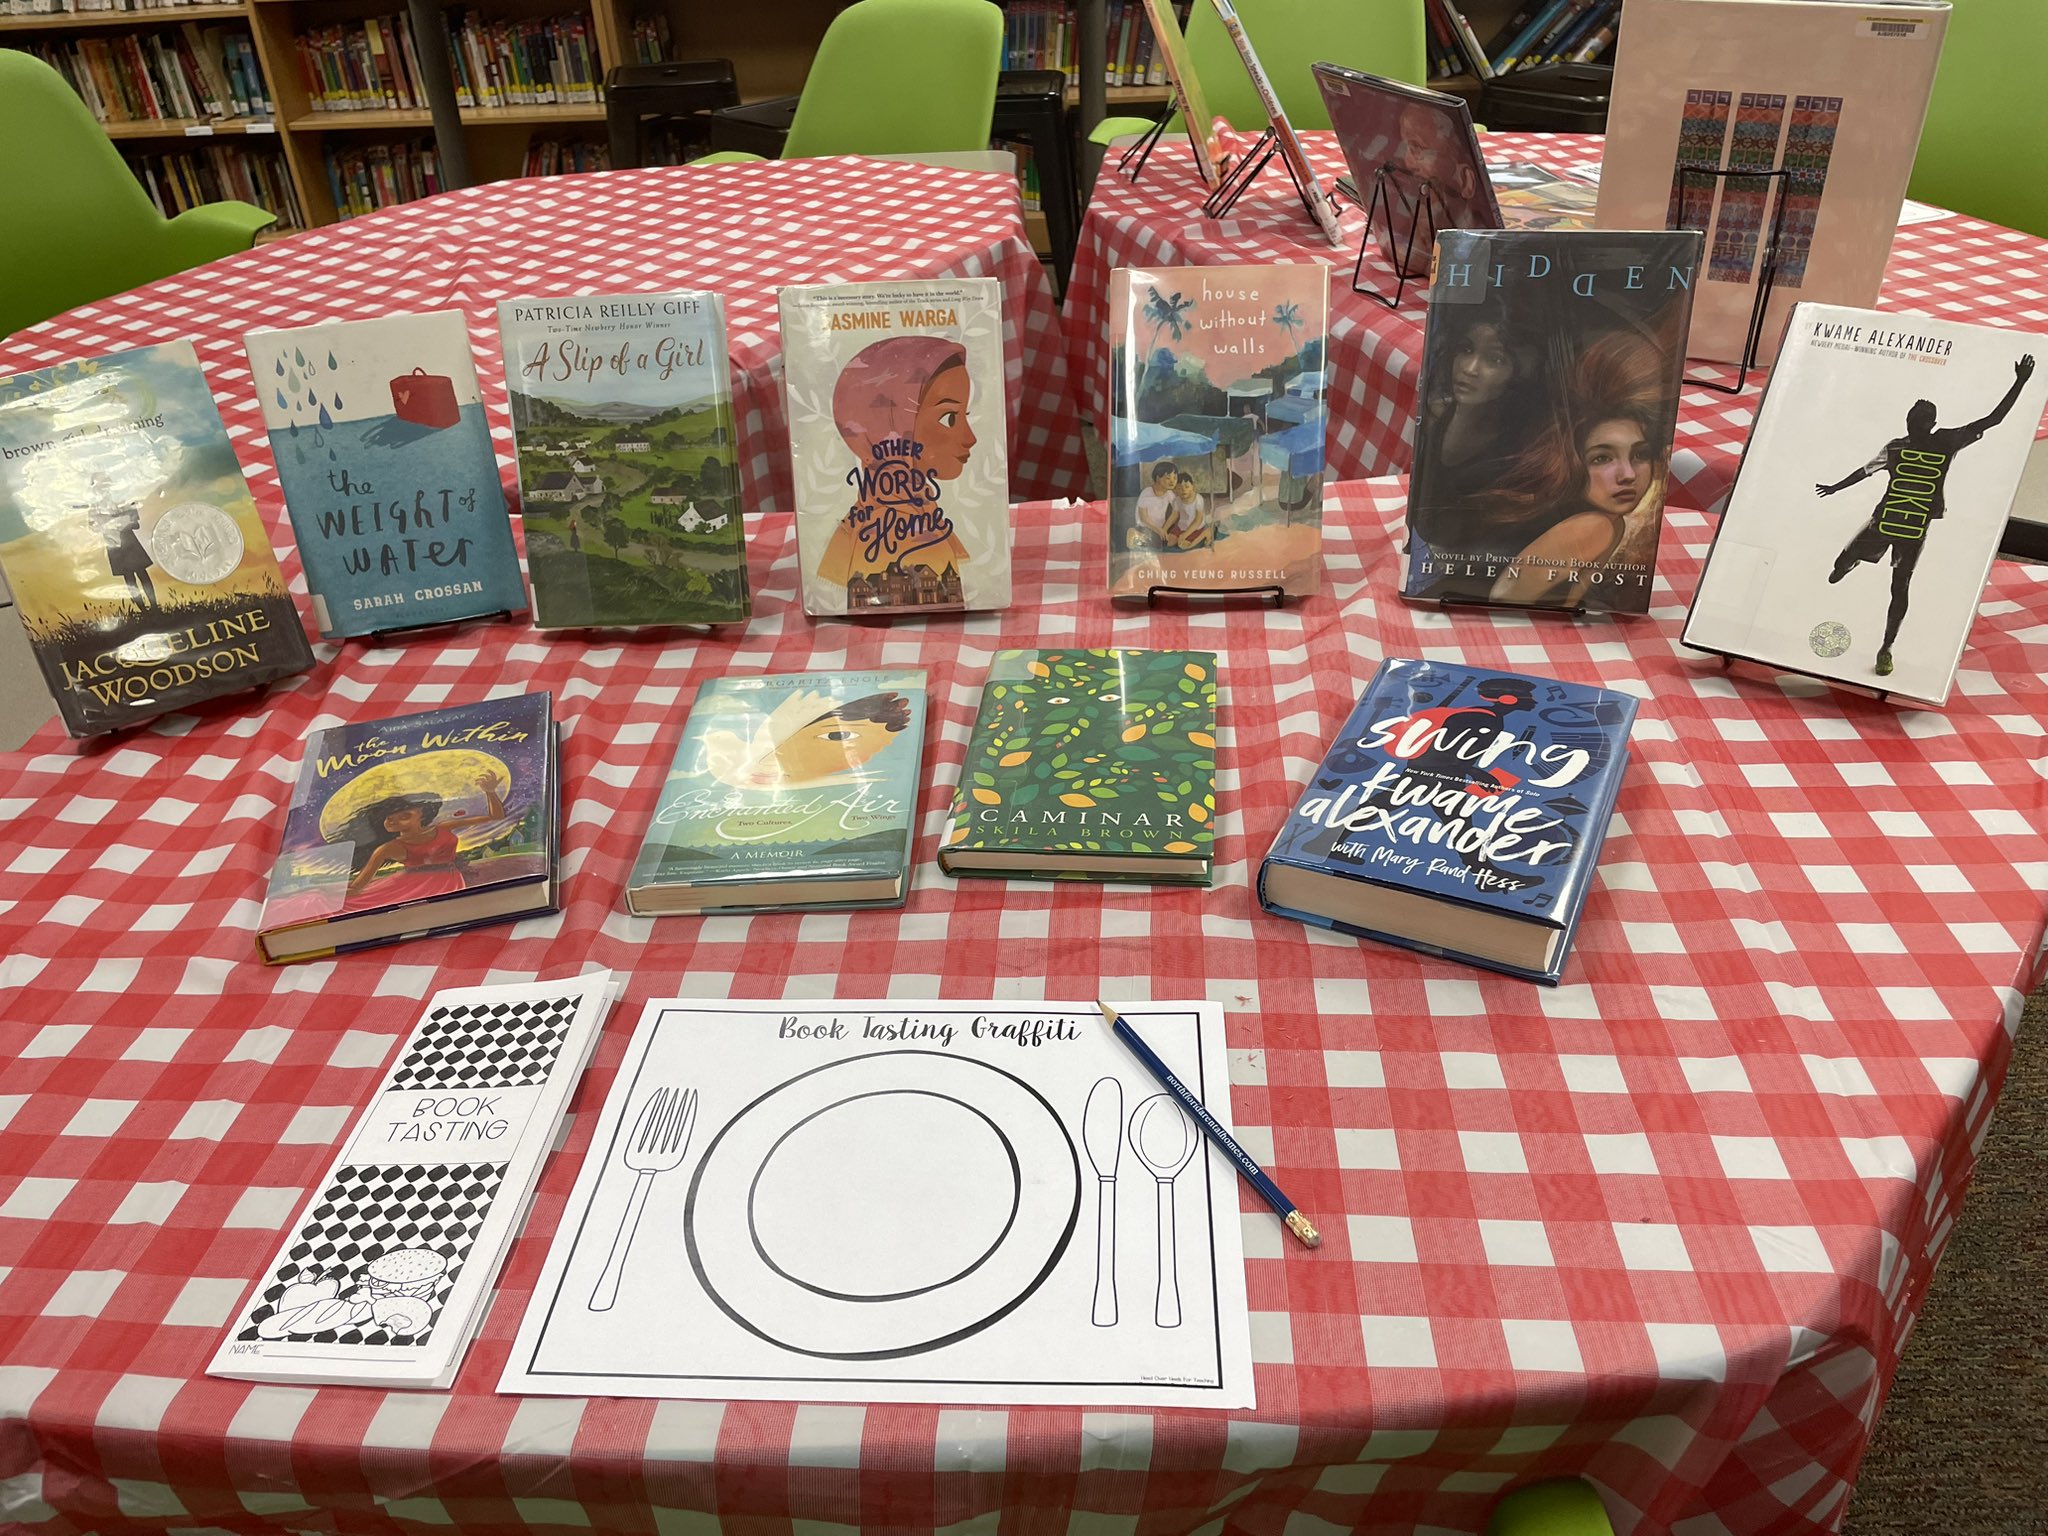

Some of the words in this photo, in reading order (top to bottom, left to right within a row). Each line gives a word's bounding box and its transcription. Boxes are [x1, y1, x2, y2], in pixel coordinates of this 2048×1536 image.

[1448, 254, 1694, 297] HIDDEN
[1202, 278, 1259, 301] house
[515, 304, 593, 322] PATRICIA
[600, 302, 656, 319] REILLY
[663, 300, 701, 316] GIFF
[825, 310, 890, 331] ASMINE
[899, 309, 958, 328] WARGA
[1200, 309, 1267, 330] without
[584, 322, 616, 333] Newbery
[619, 322, 642, 331] Honor
[646, 321, 671, 330] Winner
[1813, 321, 1863, 342] KWAME
[1868, 329, 1954, 356] ALEXANDER
[1213, 338, 1265, 355] walls
[522, 341, 551, 382] A
[552, 339, 603, 383] Slip
[610, 341, 631, 376] of
[637, 353, 649, 370] a
[655, 337, 705, 381] Girl
[2, 440, 56, 460] brown
[871, 438, 925, 461] OTHER
[327, 469, 375, 496] the
[1878, 448, 1947, 540] BOOKED
[458, 488, 477, 513] of
[847, 506, 873, 528] for
[859, 507, 954, 563] Home
[1424, 552, 1430, 560] A
[1434, 552, 1467, 562] NOVEL
[1469, 554, 1483, 563] BY
[1603, 561, 1647, 572] AUTHOR
[1137, 569, 1177, 580] CHING
[1183, 568, 1225, 580] YEUNG
[1230, 568, 1287, 580] RUSSELL
[1421, 561, 1521, 580] HELEN
[1547, 569, 1648, 587] FROST
[353, 592, 405, 611] SARAH
[414, 580, 484, 601] CROSSAN
[88, 642, 261, 707] WOODSON
[315, 743, 407, 778] Moon
[421, 721, 529, 749] Within
[354, 736, 390, 752] the
[1356, 715, 1591, 789] swing
[1419, 769, 1434, 778] York
[1435, 772, 1453, 781] Times
[1454, 776, 1489, 788] Bestselling
[829, 783, 911, 830] Air
[1361, 761, 1564, 835] kwame
[738, 820, 754, 828] Two
[851, 814, 869, 822] Two
[870, 813, 897, 823] Wings
[980, 808, 1184, 828] CAMINAR
[1299, 785, 1573, 866] alexander
[976, 825, 1058, 837] SKILA
[1081, 828, 1184, 840] BROWN
[730, 851, 741, 860] A
[1331, 840, 1368, 860] with
[1371, 846, 1425, 876] Mary
[1426, 857, 1471, 882] Rand
[1472, 868, 1528, 892] Hess
[778, 1016, 849, 1041] Book
[862, 1017, 958, 1047] Tasting
[971, 1016, 1082, 1048] Graffiti
[412, 1096, 503, 1119] BOOK
[386, 1119, 509, 1143] TASTING
[1165, 1074, 1260, 1176] northfloridarentalhomes.com
[228, 1343, 265, 1355] NAME
